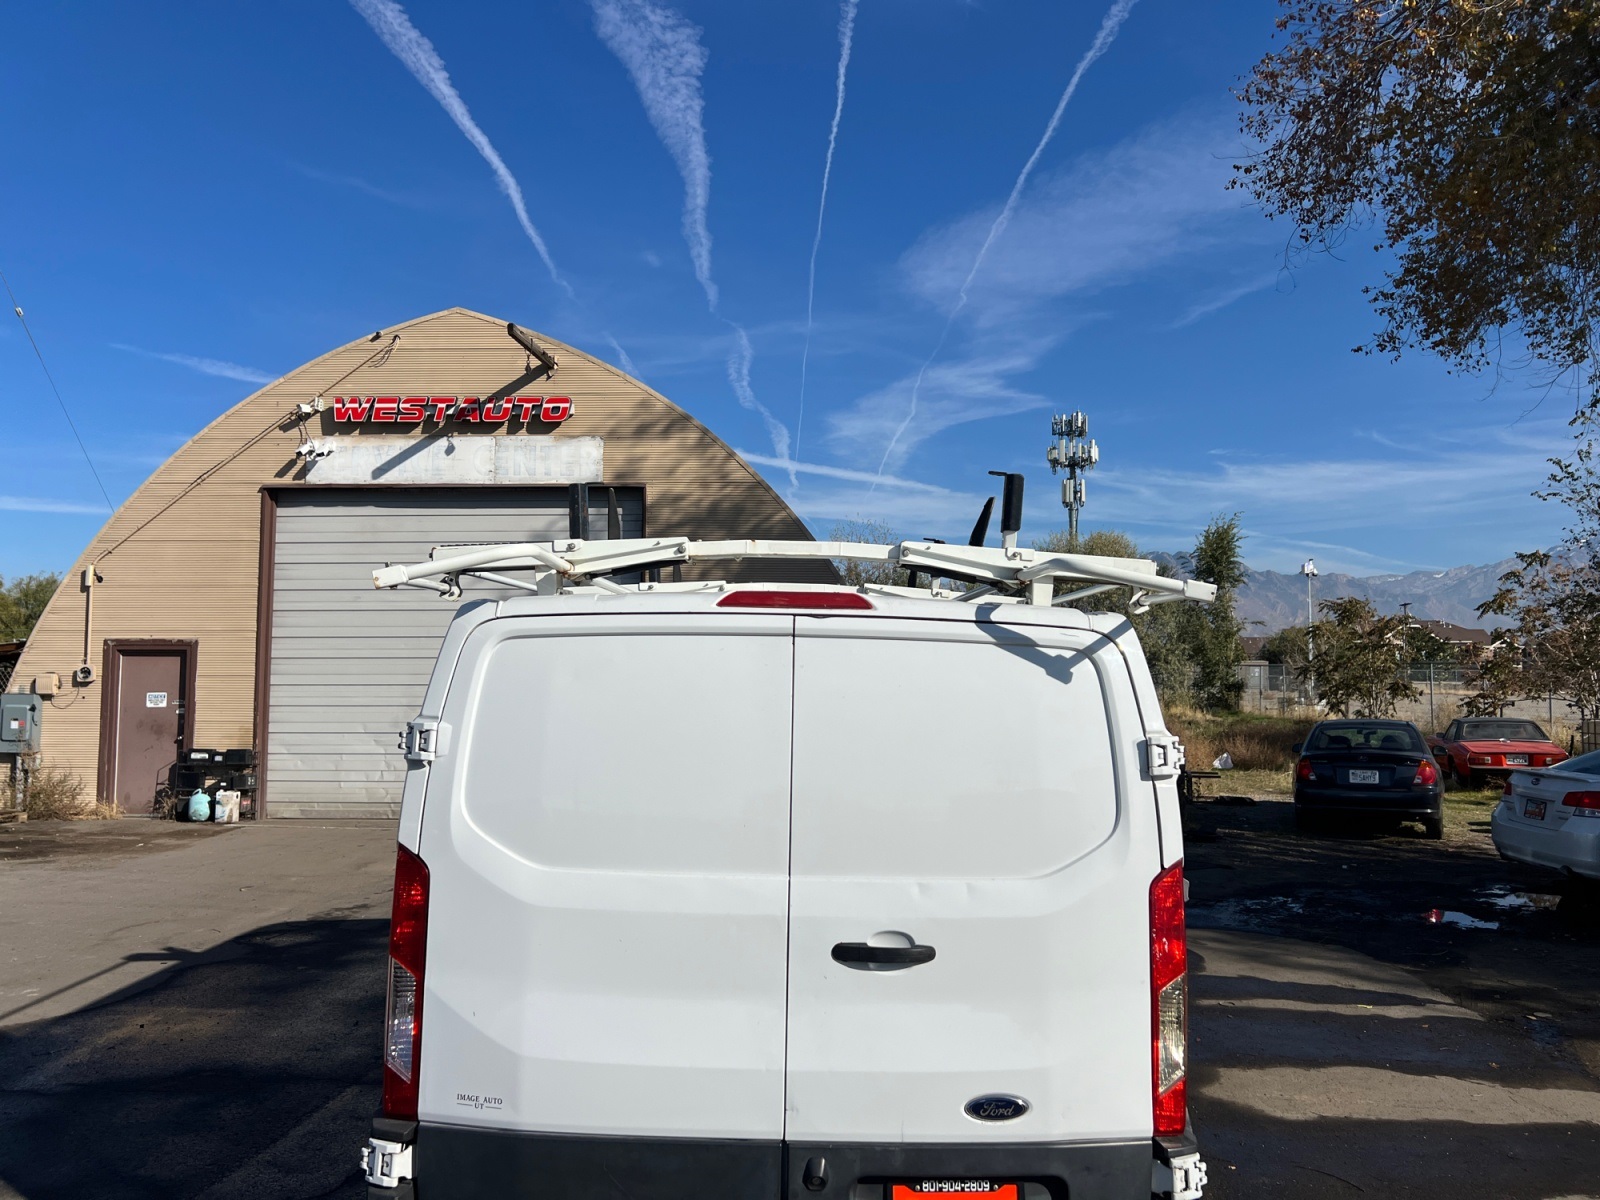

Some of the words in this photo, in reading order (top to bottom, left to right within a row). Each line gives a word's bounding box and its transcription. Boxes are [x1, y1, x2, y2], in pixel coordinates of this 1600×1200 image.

[333, 396, 573, 423] WESTAUTO
[319, 444, 446, 477] ERVICE
[457, 1094, 480, 1102] IMAGE
[483, 1096, 503, 1105] AUTO
[979, 1100, 1014, 1116] Ford
[922, 1180, 990, 1192] 801-904-2809
